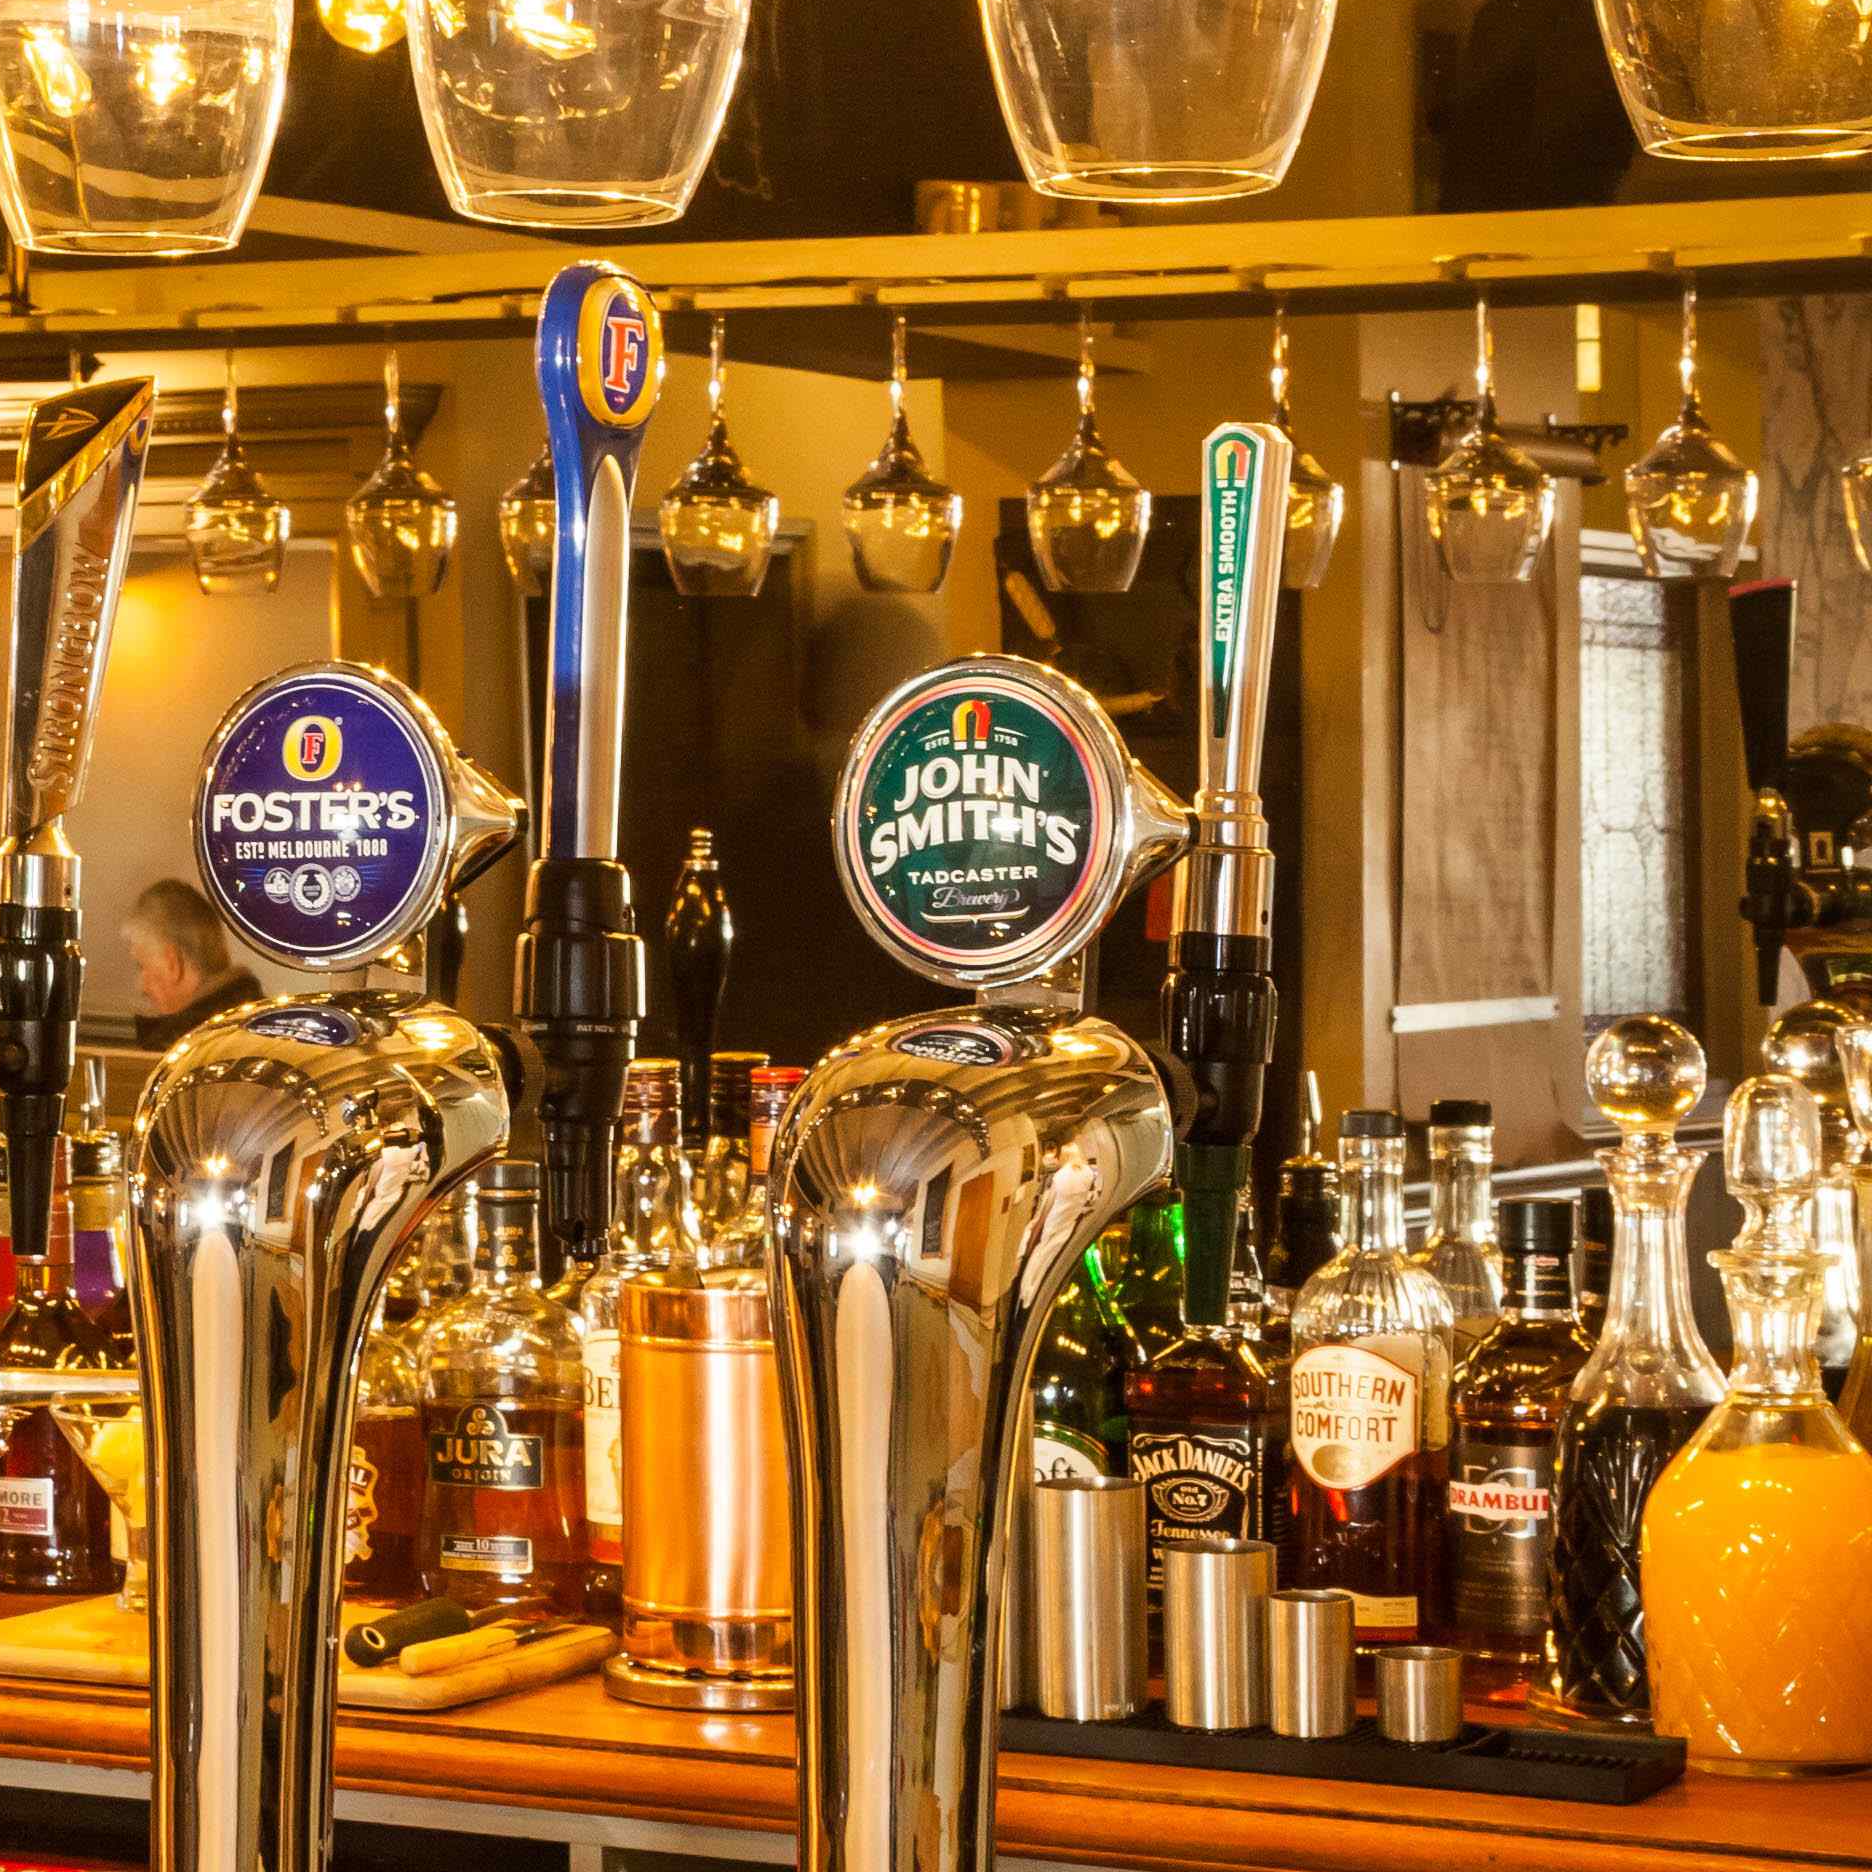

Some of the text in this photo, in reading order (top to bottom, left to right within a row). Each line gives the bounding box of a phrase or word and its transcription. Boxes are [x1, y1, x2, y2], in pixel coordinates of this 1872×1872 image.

[604, 316, 645, 394] F
[1215, 490, 1239, 642] EXTRA SMOOTH
[27, 541, 109, 798] STRONGBOW
[893, 753, 1040, 812] JOHN
[212, 791, 416, 833] FOSTER'S
[267, 840, 350, 859] MELBOURNE
[869, 800, 1078, 876] SMITH'S
[908, 865, 1039, 886] TADCASTER
[931, 886, 1021, 912] Brewery
[1293, 1371, 1406, 1407] SOUTHERN
[1296, 1410, 1398, 1443] COMFORT
[436, 1438, 533, 1468] JURA
[1132, 1447, 1177, 1484] JACK
[1178, 1440, 1256, 1493] DANIEL'S
[451, 1468, 513, 1482] ORIGIN
[1450, 1487, 1550, 1512] DRAMBUI
